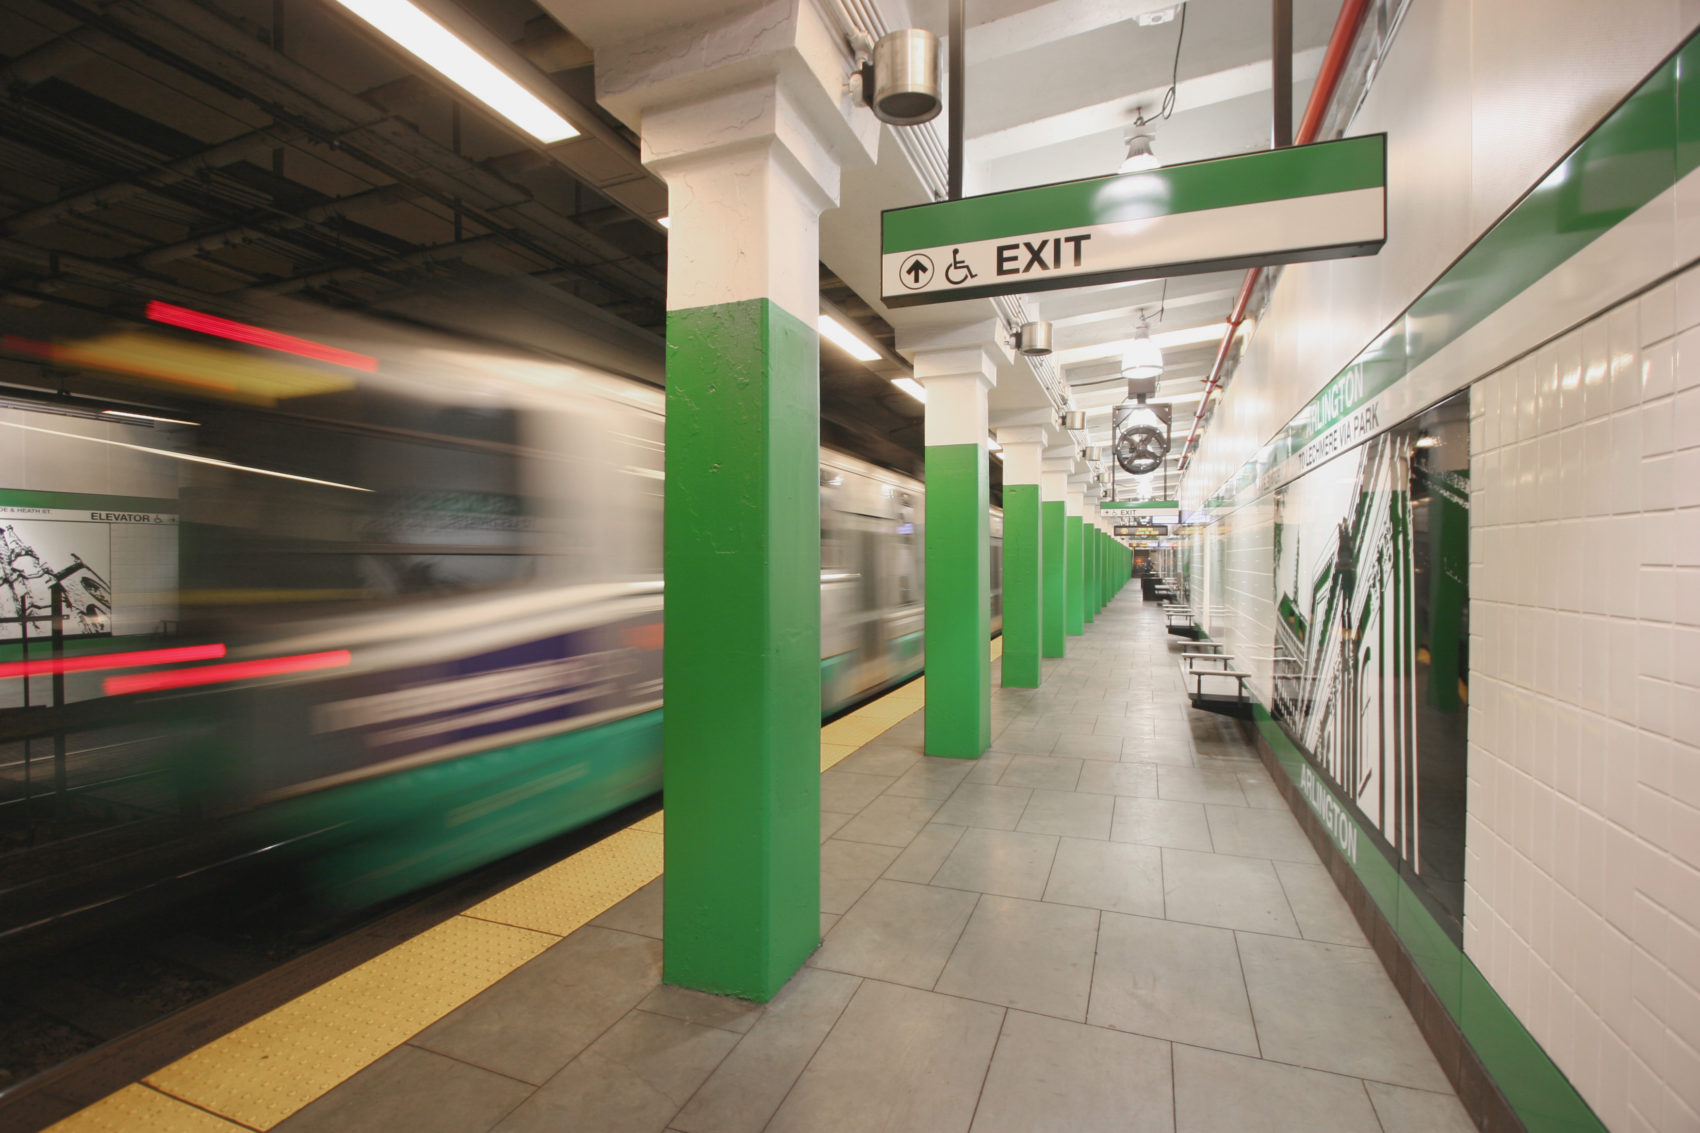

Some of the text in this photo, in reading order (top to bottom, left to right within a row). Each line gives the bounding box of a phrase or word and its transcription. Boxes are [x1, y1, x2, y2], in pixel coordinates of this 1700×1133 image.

[997, 233, 1092, 277] EXIT
[1340, 421, 1352, 447] VIA
[1354, 401, 1379, 438] PARK
[90, 512, 151, 523] ELEVATOR
[1300, 763, 1357, 865] ARLINGTON
